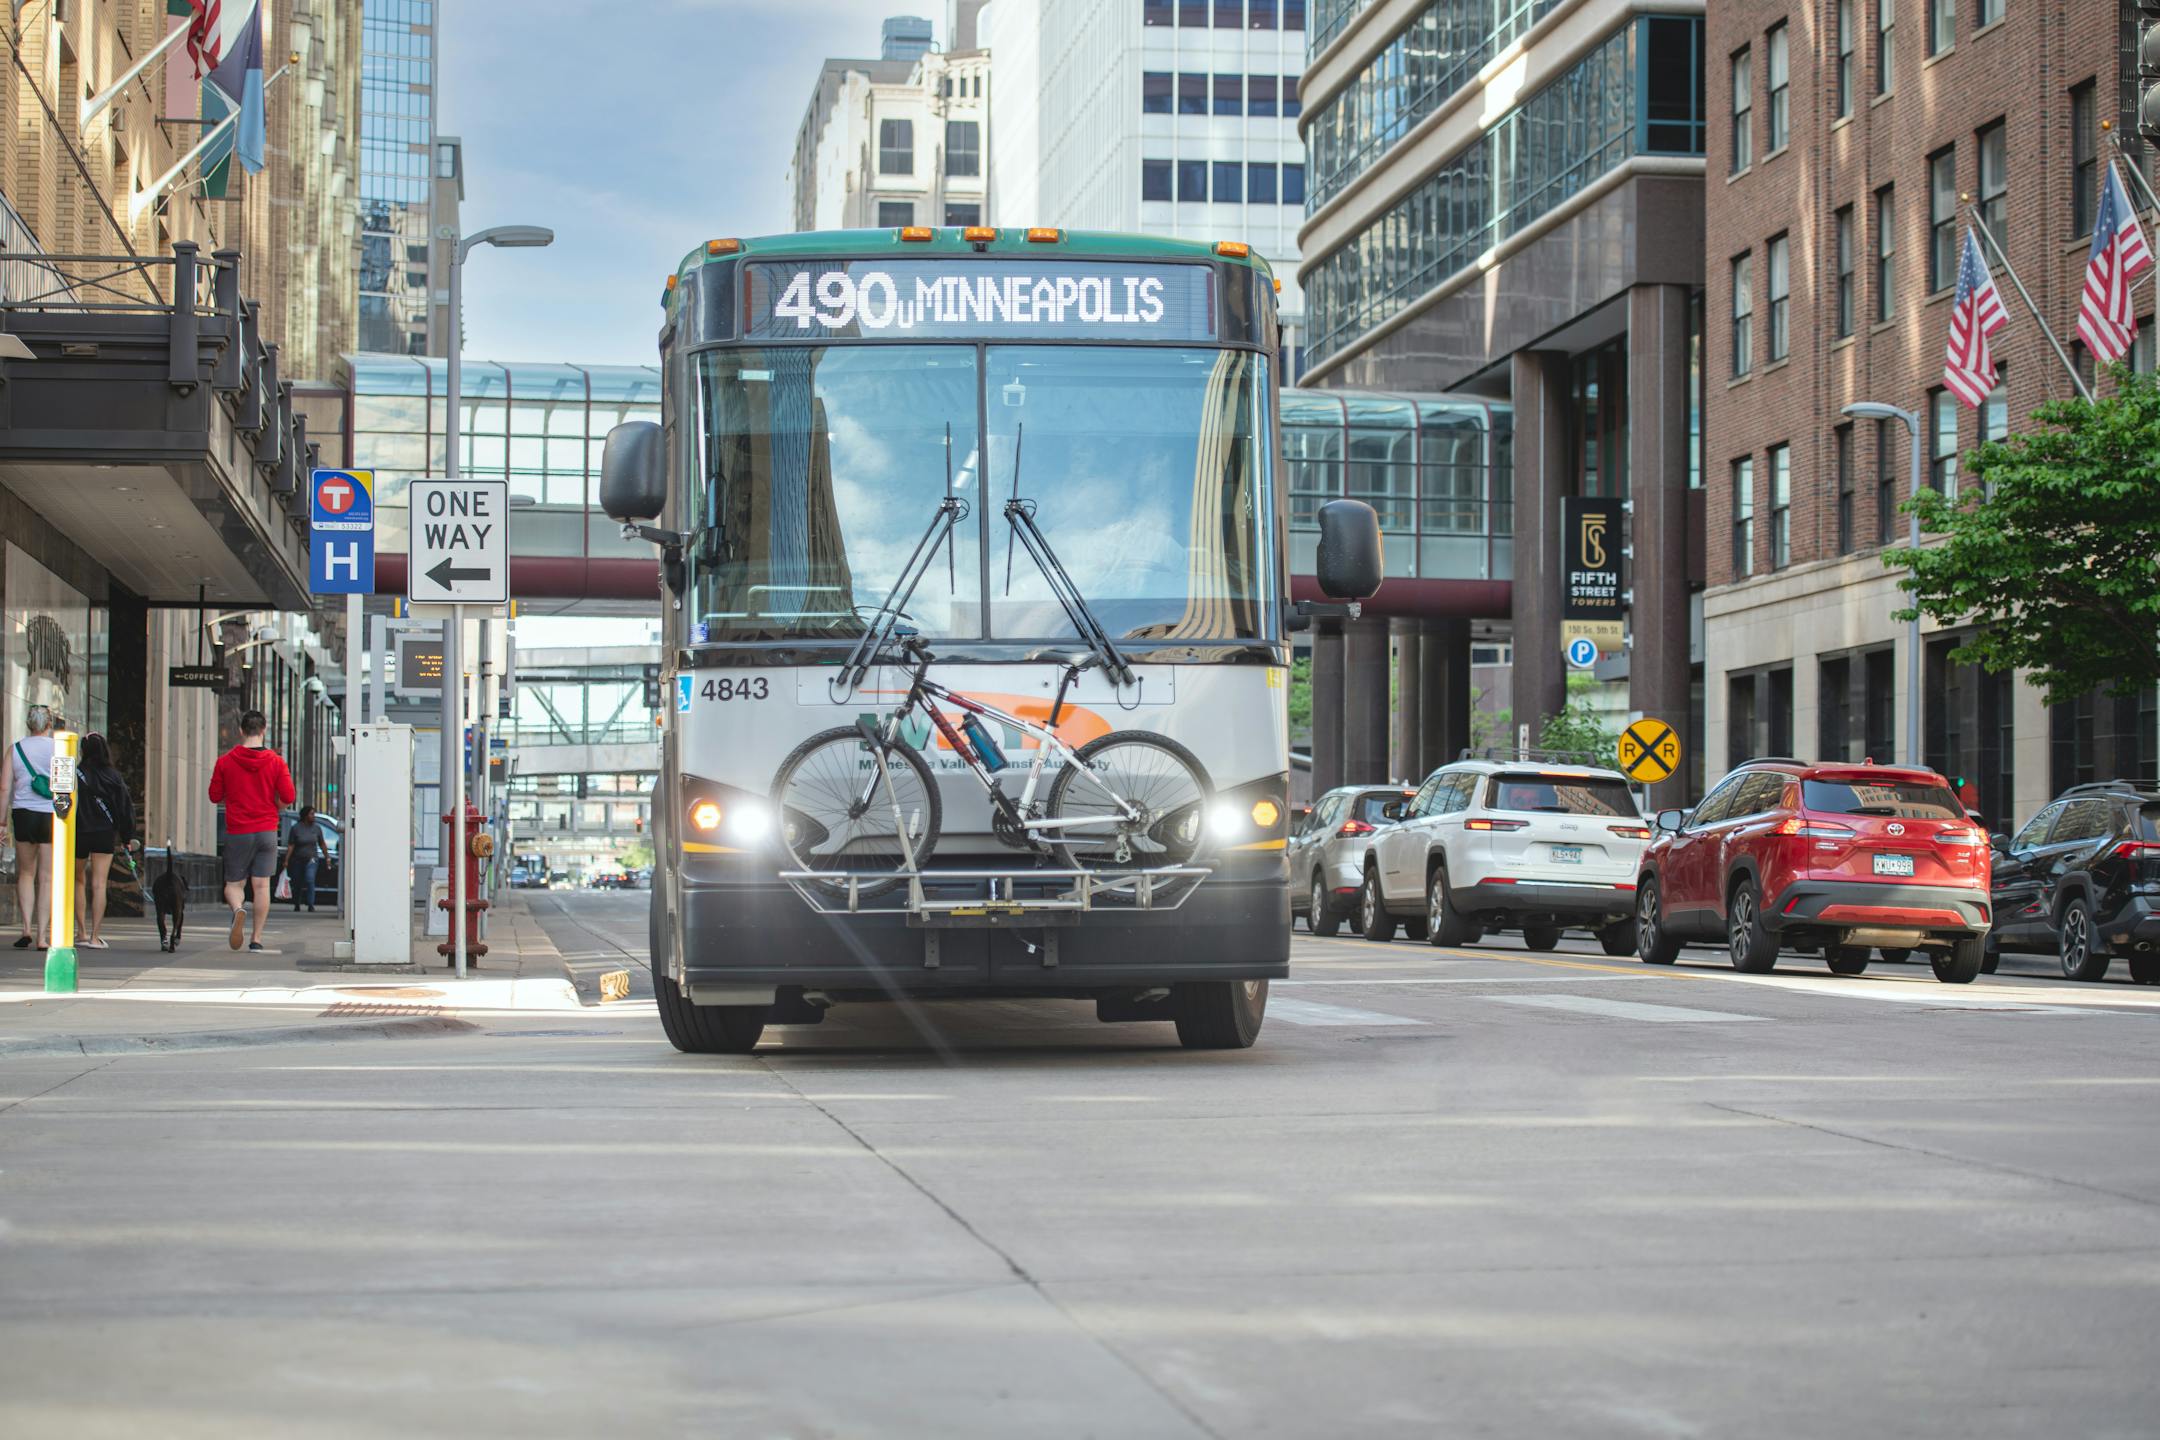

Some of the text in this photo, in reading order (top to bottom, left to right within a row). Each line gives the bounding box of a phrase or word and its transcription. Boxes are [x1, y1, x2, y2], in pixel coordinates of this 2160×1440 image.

[916, 276, 1164, 322] MINNEAPOLIS
[427, 491, 490, 517] ONE
[425, 524, 492, 550] WAY
[325, 542, 358, 580] H
[1571, 572, 1617, 585] FIFTH
[1571, 586, 1617, 597] STREET
[1571, 598, 1617, 607] TOWERS
[701, 677, 769, 701] 4843
[1624, 743, 1675, 758] R R
